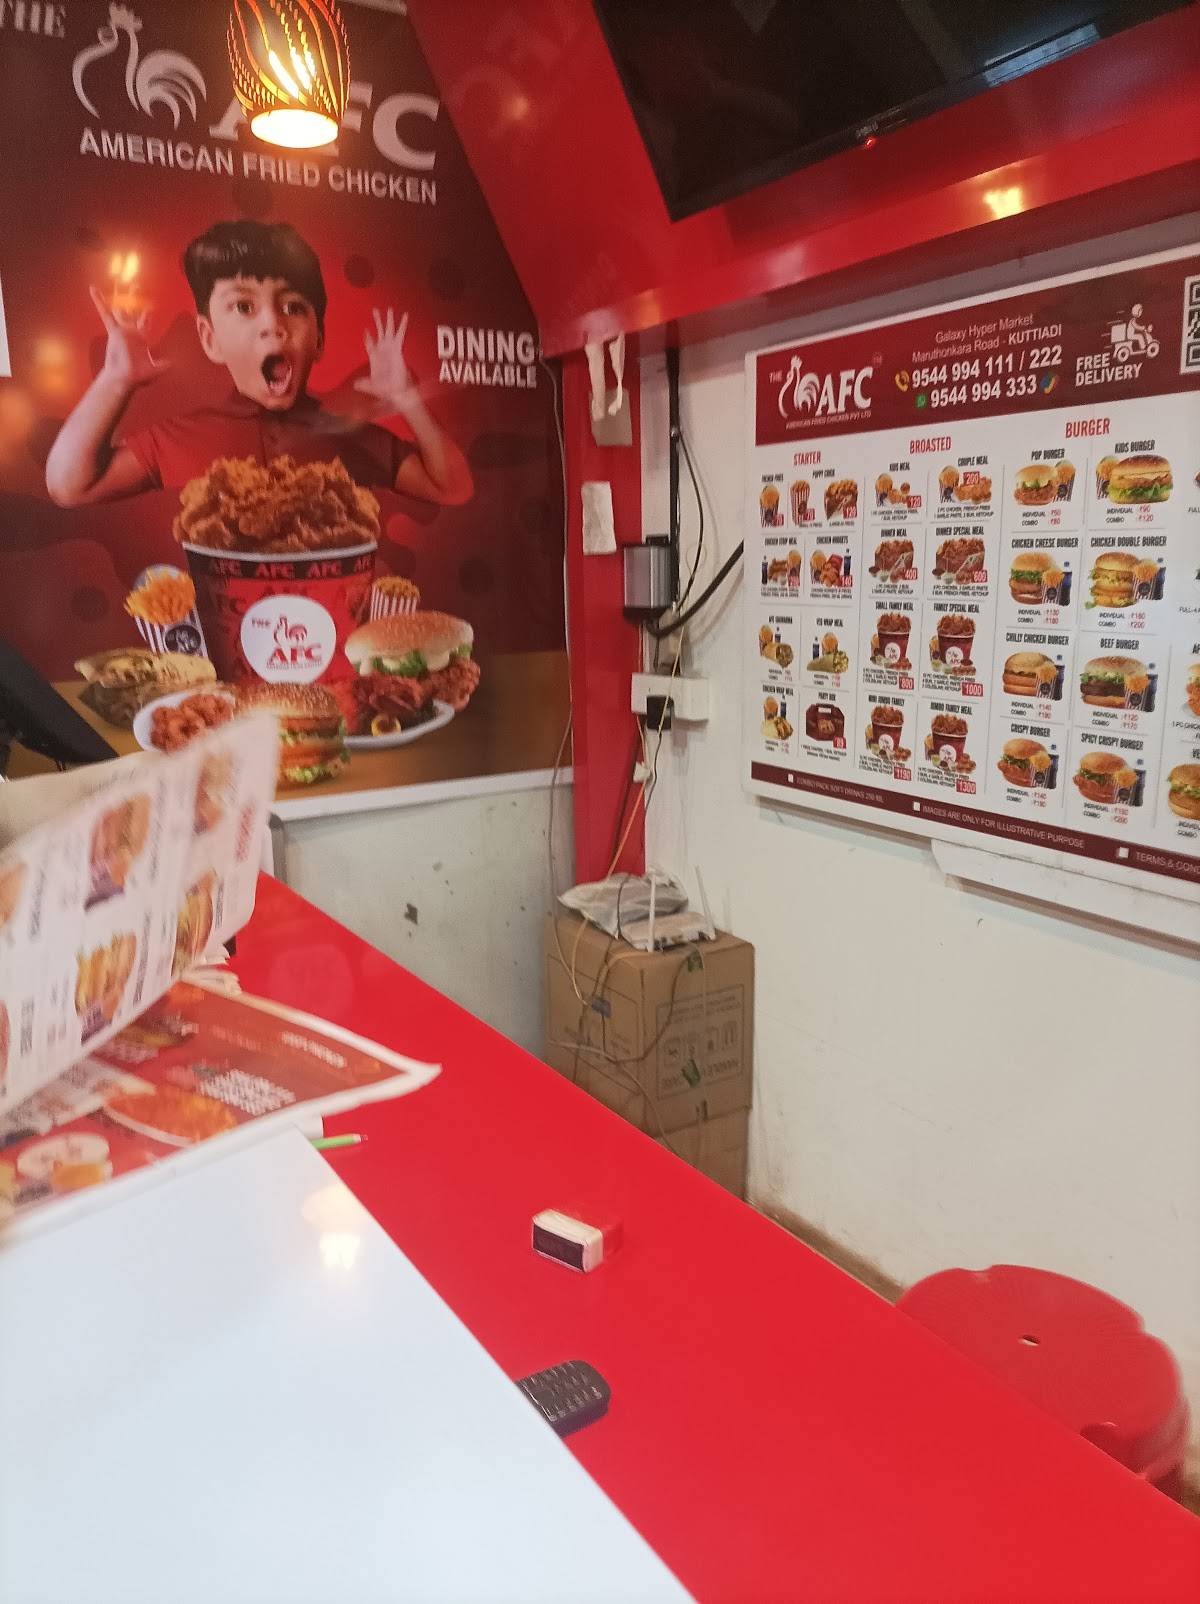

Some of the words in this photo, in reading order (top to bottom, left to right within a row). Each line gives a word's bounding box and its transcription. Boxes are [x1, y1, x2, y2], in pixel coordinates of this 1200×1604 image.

[80, 126, 234, 176] AMERICAN
[243, 151, 321, 188] FRIED
[328, 164, 437, 206] CHICKEN
[935, 330, 967, 344] Galaxy
[969, 323, 998, 340] Hyper
[1000, 313, 1034, 332] Market
[437, 324, 535, 366] DINING
[912, 344, 972, 363] Maruthonkara
[974, 336, 1000, 351] Road
[1008, 323, 1062, 345] KUTTIADI
[912, 365, 947, 388] 9544
[951, 358, 980, 382] 994
[985, 352, 1014, 376] 111
[1018, 350, 1025, 371] /
[1029, 344, 1063, 369] 222
[1076, 352, 1110, 371] FREE
[439, 360, 537, 389] AVAILABLE
[769, 370, 783, 383] THE
[1075, 363, 1143, 387] DELIVERY
[815, 366, 874, 416] AFC
[930, 385, 967, 408] 9544
[972, 380, 1001, 402] 994
[1006, 374, 1037, 398] 333
[1065, 418, 1111, 439] BURGER
[909, 437, 952, 454] BROASTED
[1114, 442, 1129, 454] KIDS
[1130, 439, 1156, 452] BURGER
[793, 451, 822, 466] STARTER
[976, 455, 988, 466] MEAL
[1031, 449, 1042, 461] POP
[1043, 448, 1065, 460] BURGER
[896, 528, 907, 537] MEAL
[953, 526, 971, 536] SPECIAL
[972, 526, 984, 536] MEAL
[1011, 538, 1034, 549] CHICKEN
[1035, 537, 1055, 548] CHEESE
[1056, 537, 1079, 548] BURGER
[1090, 536, 1115, 548] CHICKEN
[1117, 536, 1141, 547] DOUBLE
[1142, 535, 1168, 547] BURGER
[903, 602, 914, 612] MEAL
[949, 603, 967, 613] SPECIAL
[967, 604, 980, 614] MEAL
[1006, 632, 1024, 643] CHILLY
[1024, 633, 1047, 644] CHICKEN
[1047, 634, 1069, 646] BURGER
[1100, 638, 1115, 649] BEEF
[1115, 638, 1140, 650] BURGER
[266, 643, 323, 666] AFC
[960, 705, 973, 715] MEAL
[1010, 723, 1029, 735] CRISPY
[1029, 725, 1051, 738] BURGER
[1081, 732, 1098, 745] SPICY
[1098, 734, 1119, 748] CRISPY
[1119, 737, 1144, 750] BURGER
[922, 804, 946, 817] IMAGES
[948, 810, 960, 820] ARE
[961, 812, 979, 824] ONLY
[980, 816, 995, 828] FOR
[996, 820, 1046, 840] ILLUSTRATIVE
[1047, 829, 1085, 848] PURPOSE
[1135, 851, 1166, 866] TERMS
